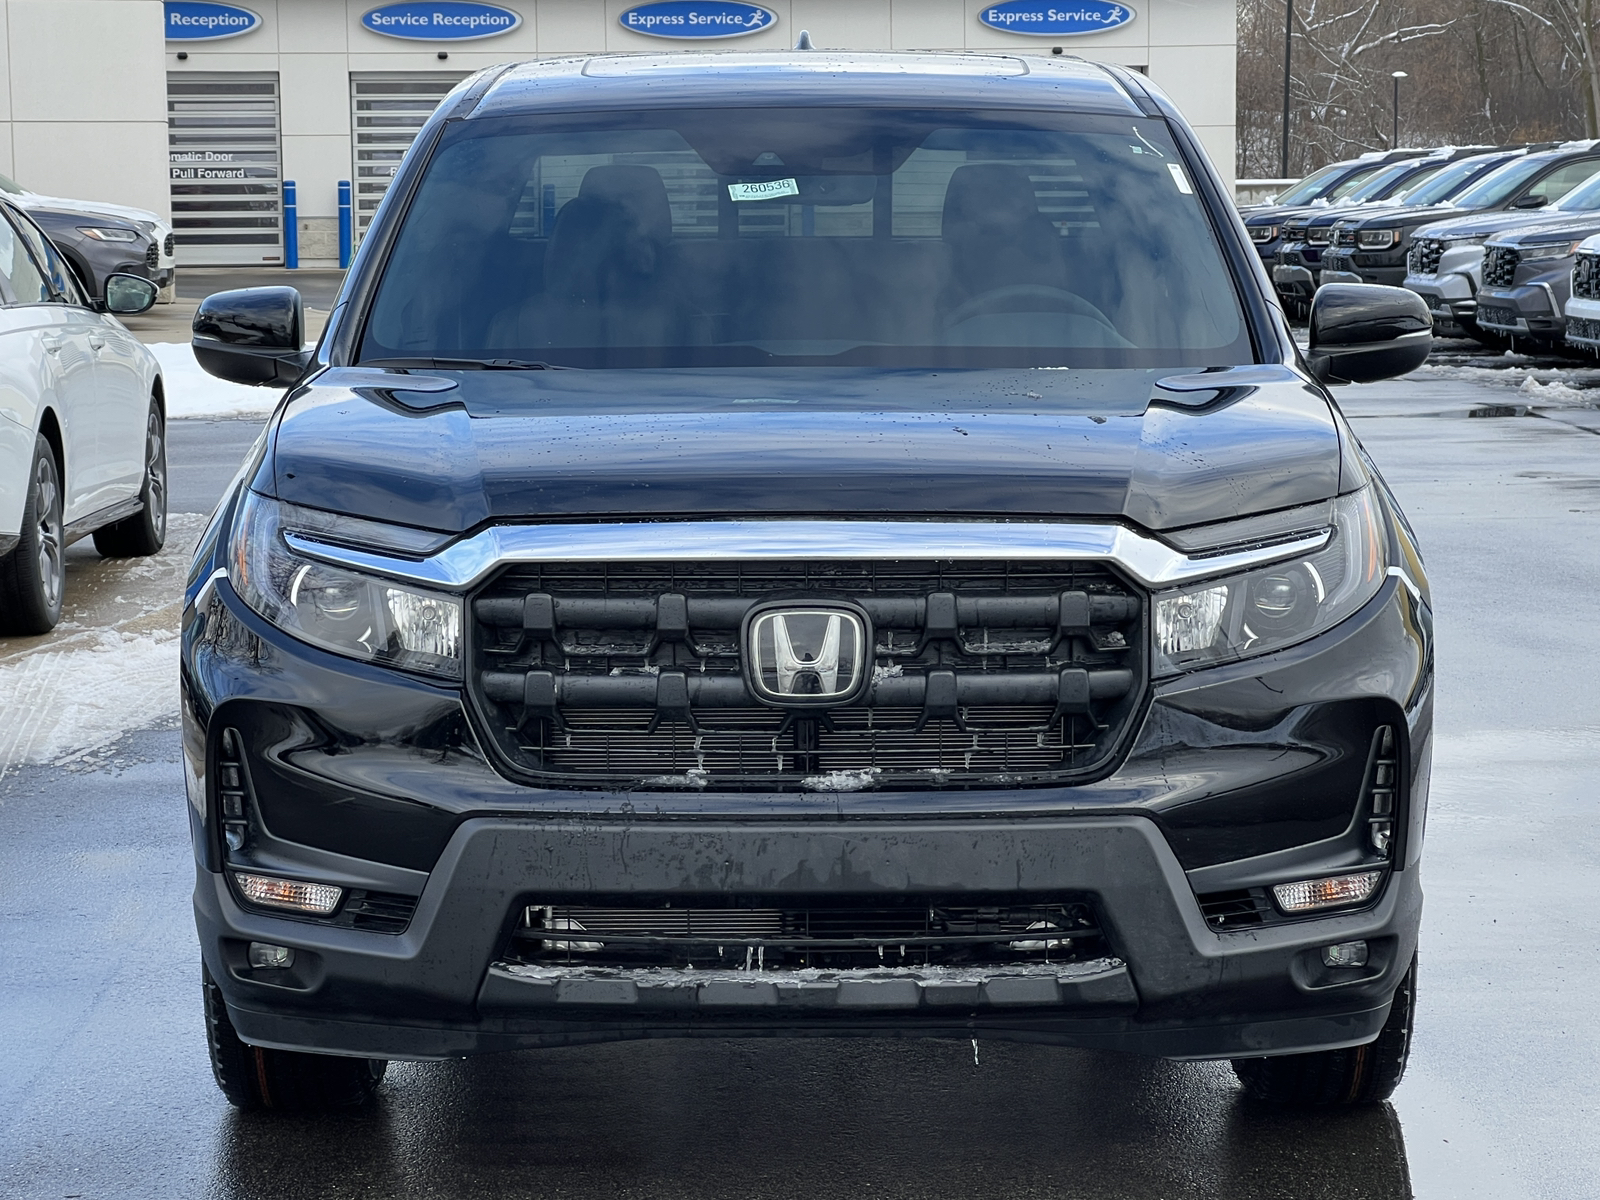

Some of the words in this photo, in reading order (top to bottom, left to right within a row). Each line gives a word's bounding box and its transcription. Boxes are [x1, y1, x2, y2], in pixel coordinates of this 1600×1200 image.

[170, 12, 249, 29] Reception
[371, 12, 429, 26] Service
[432, 12, 510, 29] Reception
[628, 12, 685, 28] Express
[688, 11, 743, 25] Service
[988, 9, 1044, 25] Express
[1047, 9, 1101, 21] Service
[169, 151, 202, 162] matic
[205, 151, 234, 162] Door
[172, 168, 195, 179] Pull
[197, 168, 245, 179] Forward
[741, 179, 791, 194] 260536
